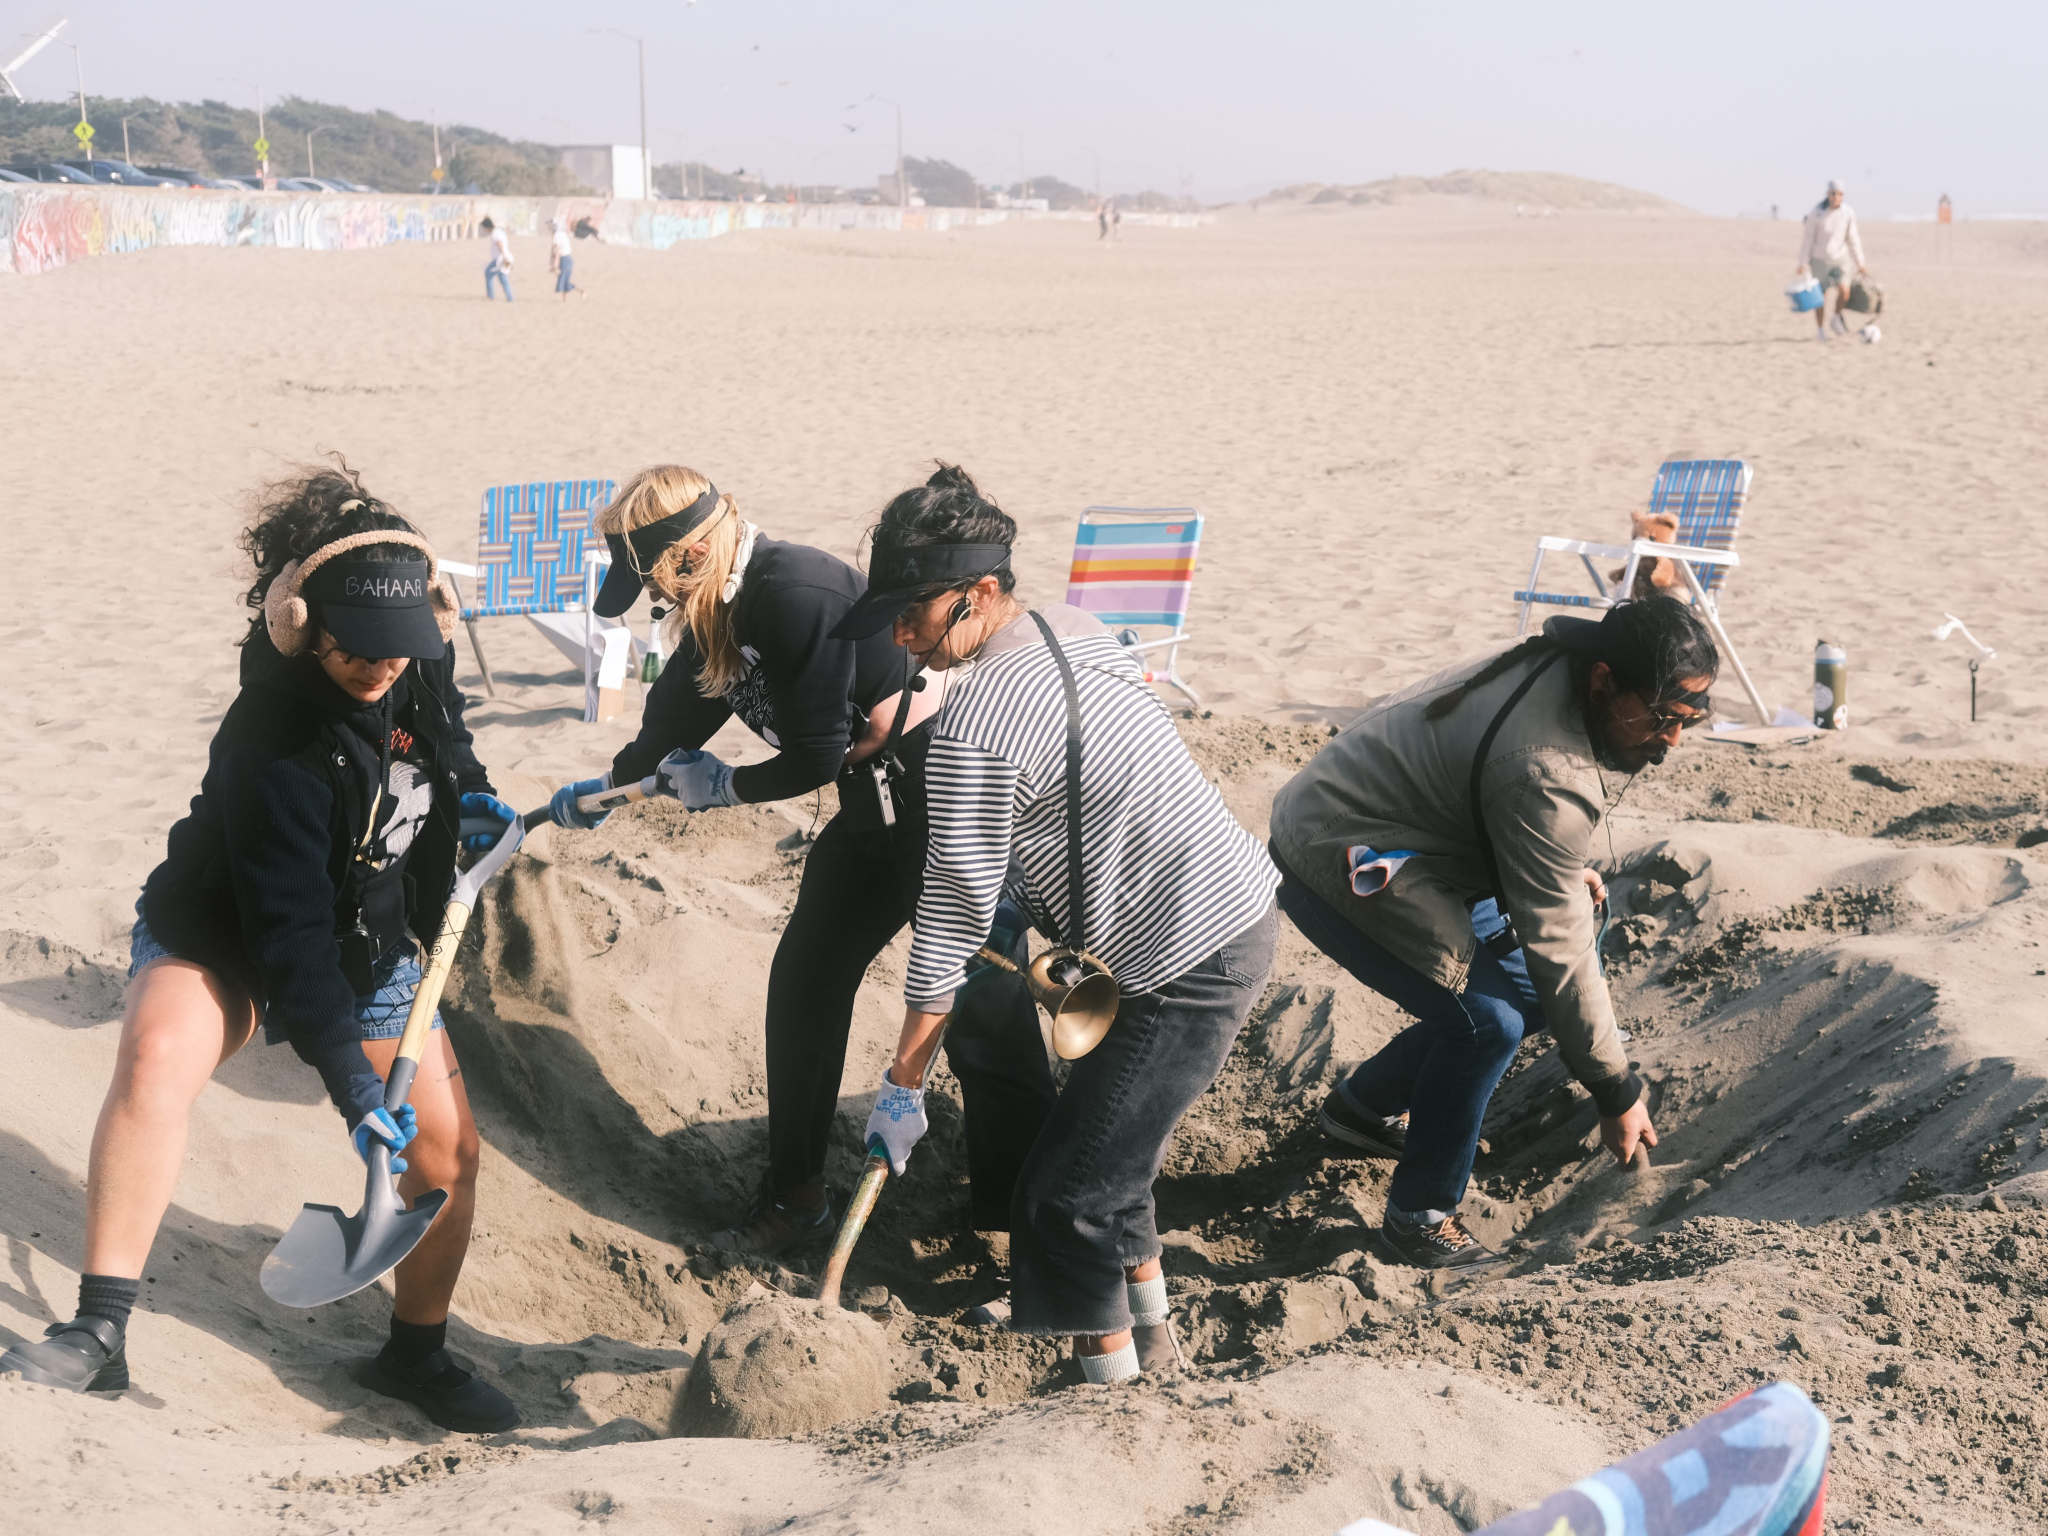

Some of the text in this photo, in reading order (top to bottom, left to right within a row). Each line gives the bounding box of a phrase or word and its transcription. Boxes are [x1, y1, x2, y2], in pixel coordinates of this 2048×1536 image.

[346, 576, 422, 598] BAHAAR
[423, 957, 434, 979] SOURCE
[881, 1099, 914, 1109] ATLAS
